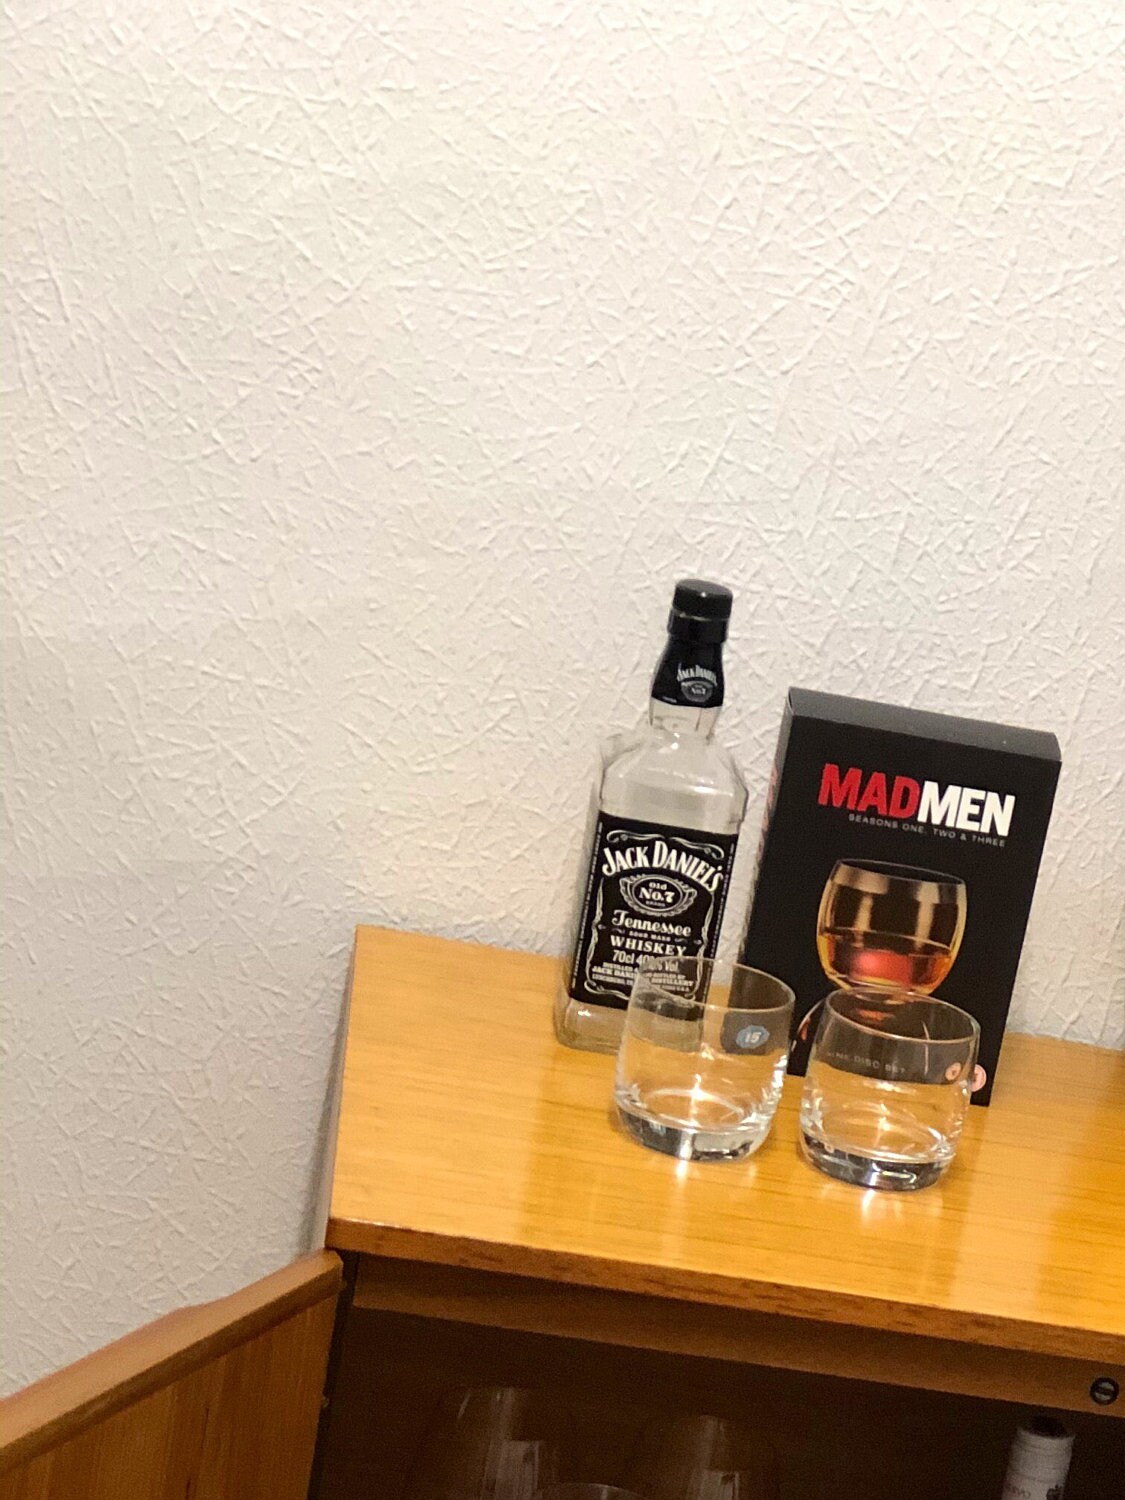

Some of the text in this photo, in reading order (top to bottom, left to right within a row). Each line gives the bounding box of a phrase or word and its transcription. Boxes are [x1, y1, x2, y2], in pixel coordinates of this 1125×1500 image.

[848, 813, 899, 828] SEASONS
[933, 828, 956, 839] TWO
[972, 835, 1006, 847] THREE
[602, 840, 724, 892] JACK DANIEL'S
[611, 909, 692, 937] Tennessee
[610, 935, 687, 957] WHISKEY
